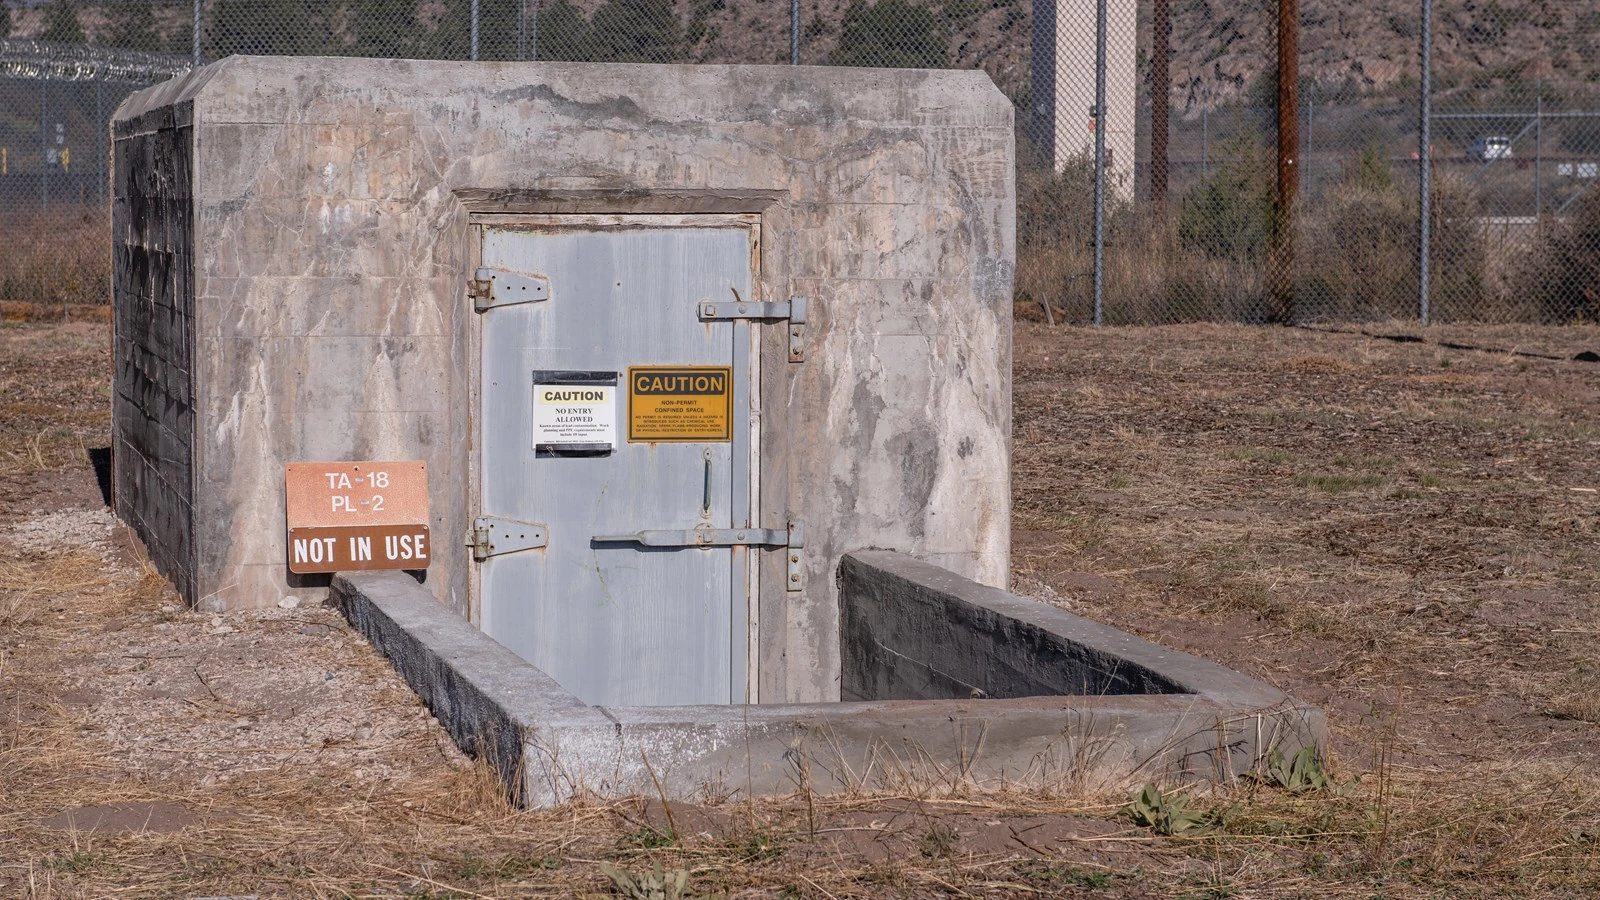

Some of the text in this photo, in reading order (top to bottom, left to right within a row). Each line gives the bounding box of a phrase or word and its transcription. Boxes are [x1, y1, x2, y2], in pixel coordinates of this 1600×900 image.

[636, 376, 723, 392] CAUTION
[544, 391, 604, 401] CAUTION
[294, 534, 427, 564] NOT IN USE
